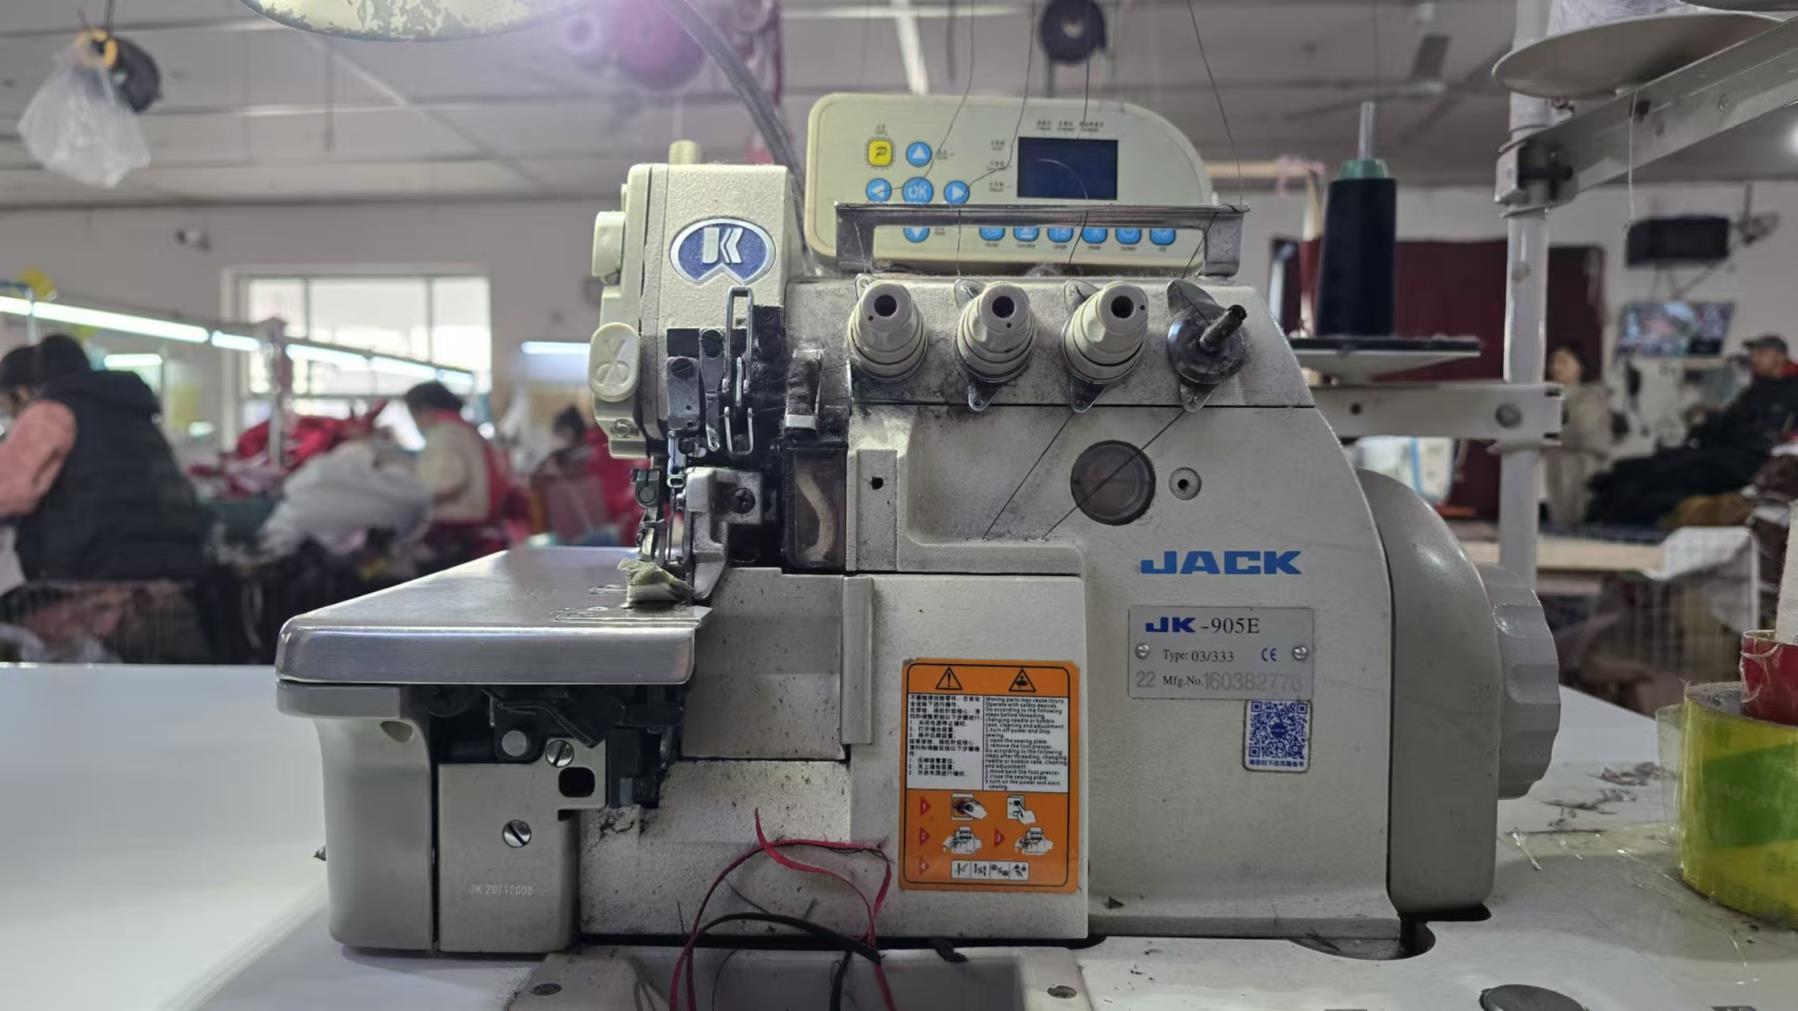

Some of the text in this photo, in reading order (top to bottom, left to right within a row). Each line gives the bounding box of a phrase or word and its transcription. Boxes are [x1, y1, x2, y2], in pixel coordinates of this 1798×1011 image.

[908, 185, 929, 199] OK
[1141, 551, 1302, 574] JACK
[1163, 650, 1189, 662] Type:
[1191, 650, 1234, 662] 03/333
[1136, 671, 1156, 688] 22
